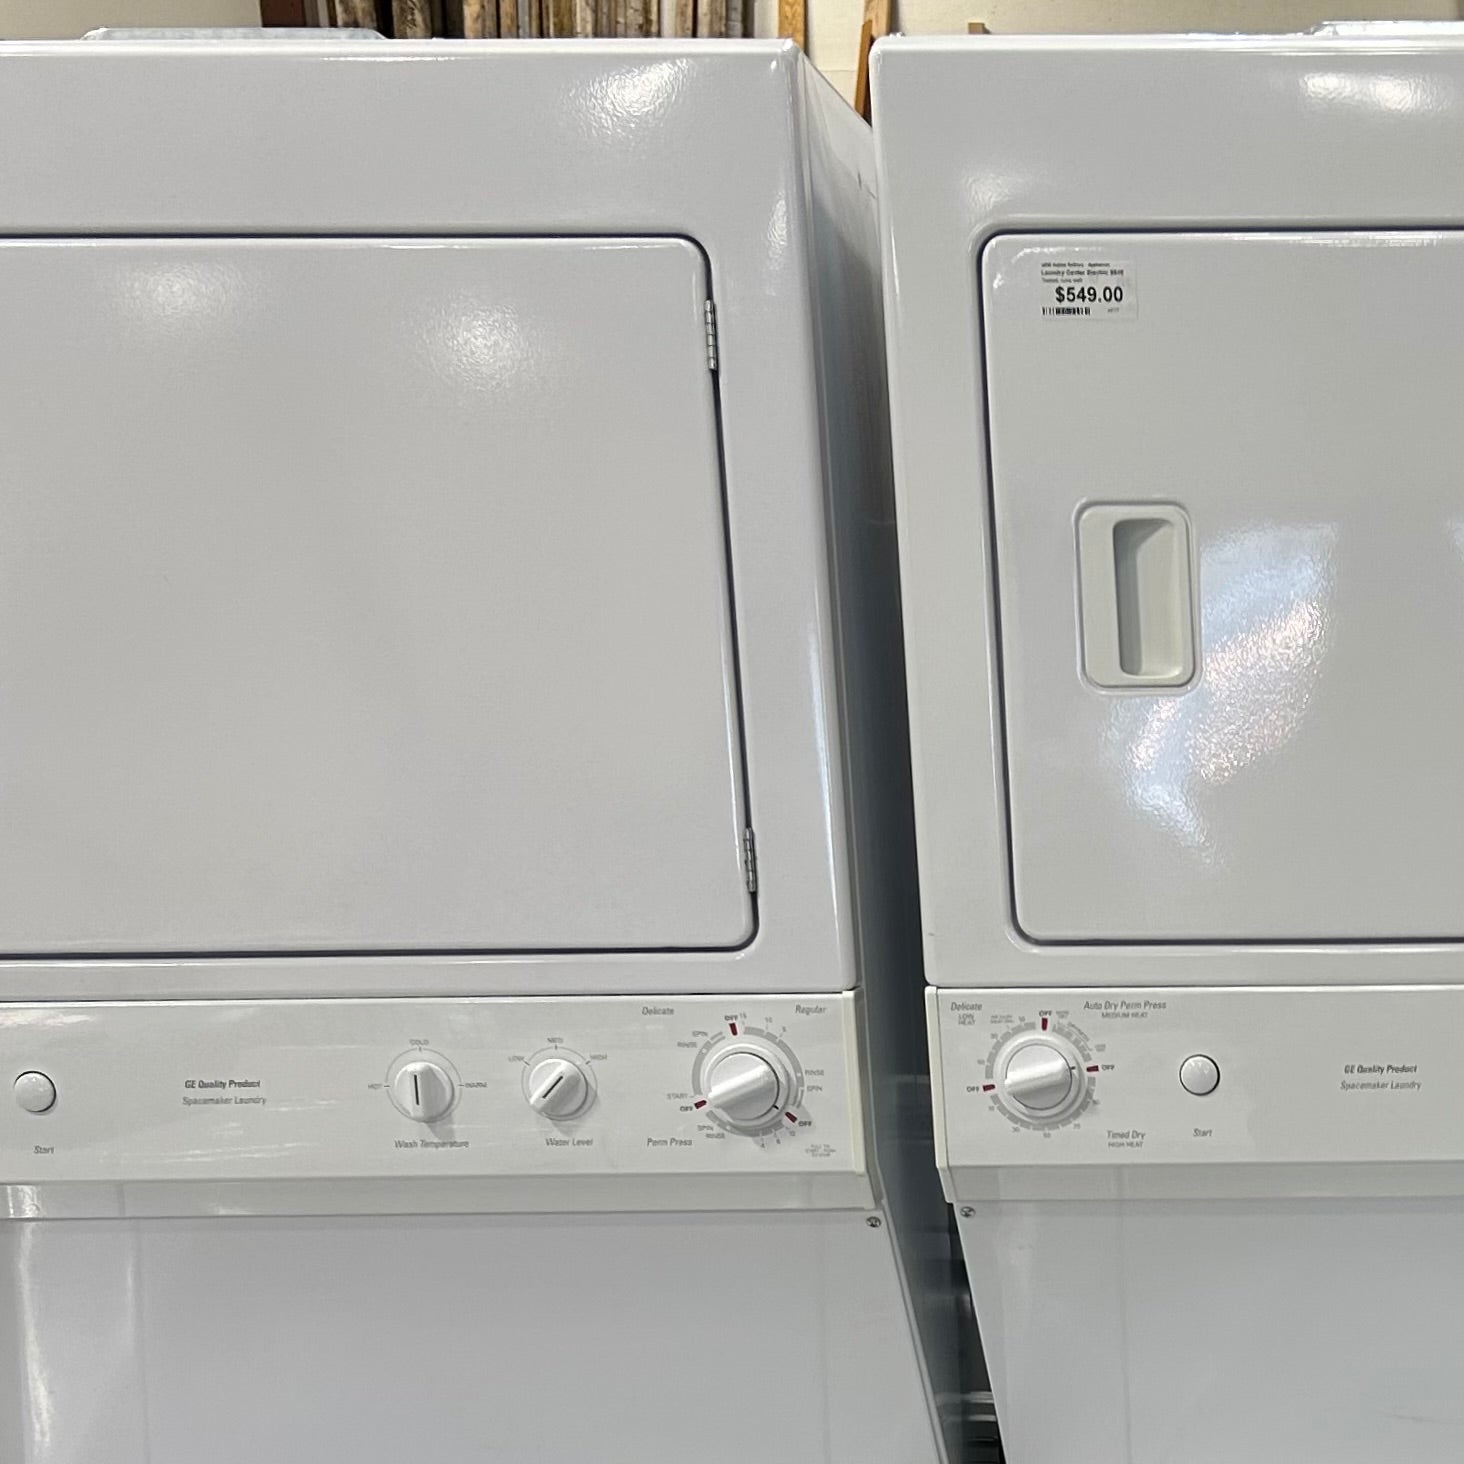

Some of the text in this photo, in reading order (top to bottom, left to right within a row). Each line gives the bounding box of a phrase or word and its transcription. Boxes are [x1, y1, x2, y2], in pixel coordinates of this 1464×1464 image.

[1055, 286, 1124, 304] $549.00
[641, 1006, 675, 1016] Delicate
[795, 1004, 827, 1016] Regular
[950, 1002, 983, 1012] Delicate
[1083, 1000, 1167, 1011] Auto Dry Perm Press
[1344, 1063, 1418, 1076] GE Quality Product
[184, 1079, 262, 1091] GE Quality Product
[1340, 1079, 1422, 1091] Spacemaker Laundry
[182, 1095, 267, 1107] Spacemaker Laundry
[1106, 1130, 1146, 1140] Timed Dry
[1192, 1128, 1213, 1138] Start
[394, 1139, 470, 1150] Wash Temperature
[545, 1137, 594, 1147] Water Level
[646, 1137, 693, 1147] Perm Press
[33, 1144, 55, 1155] Start
